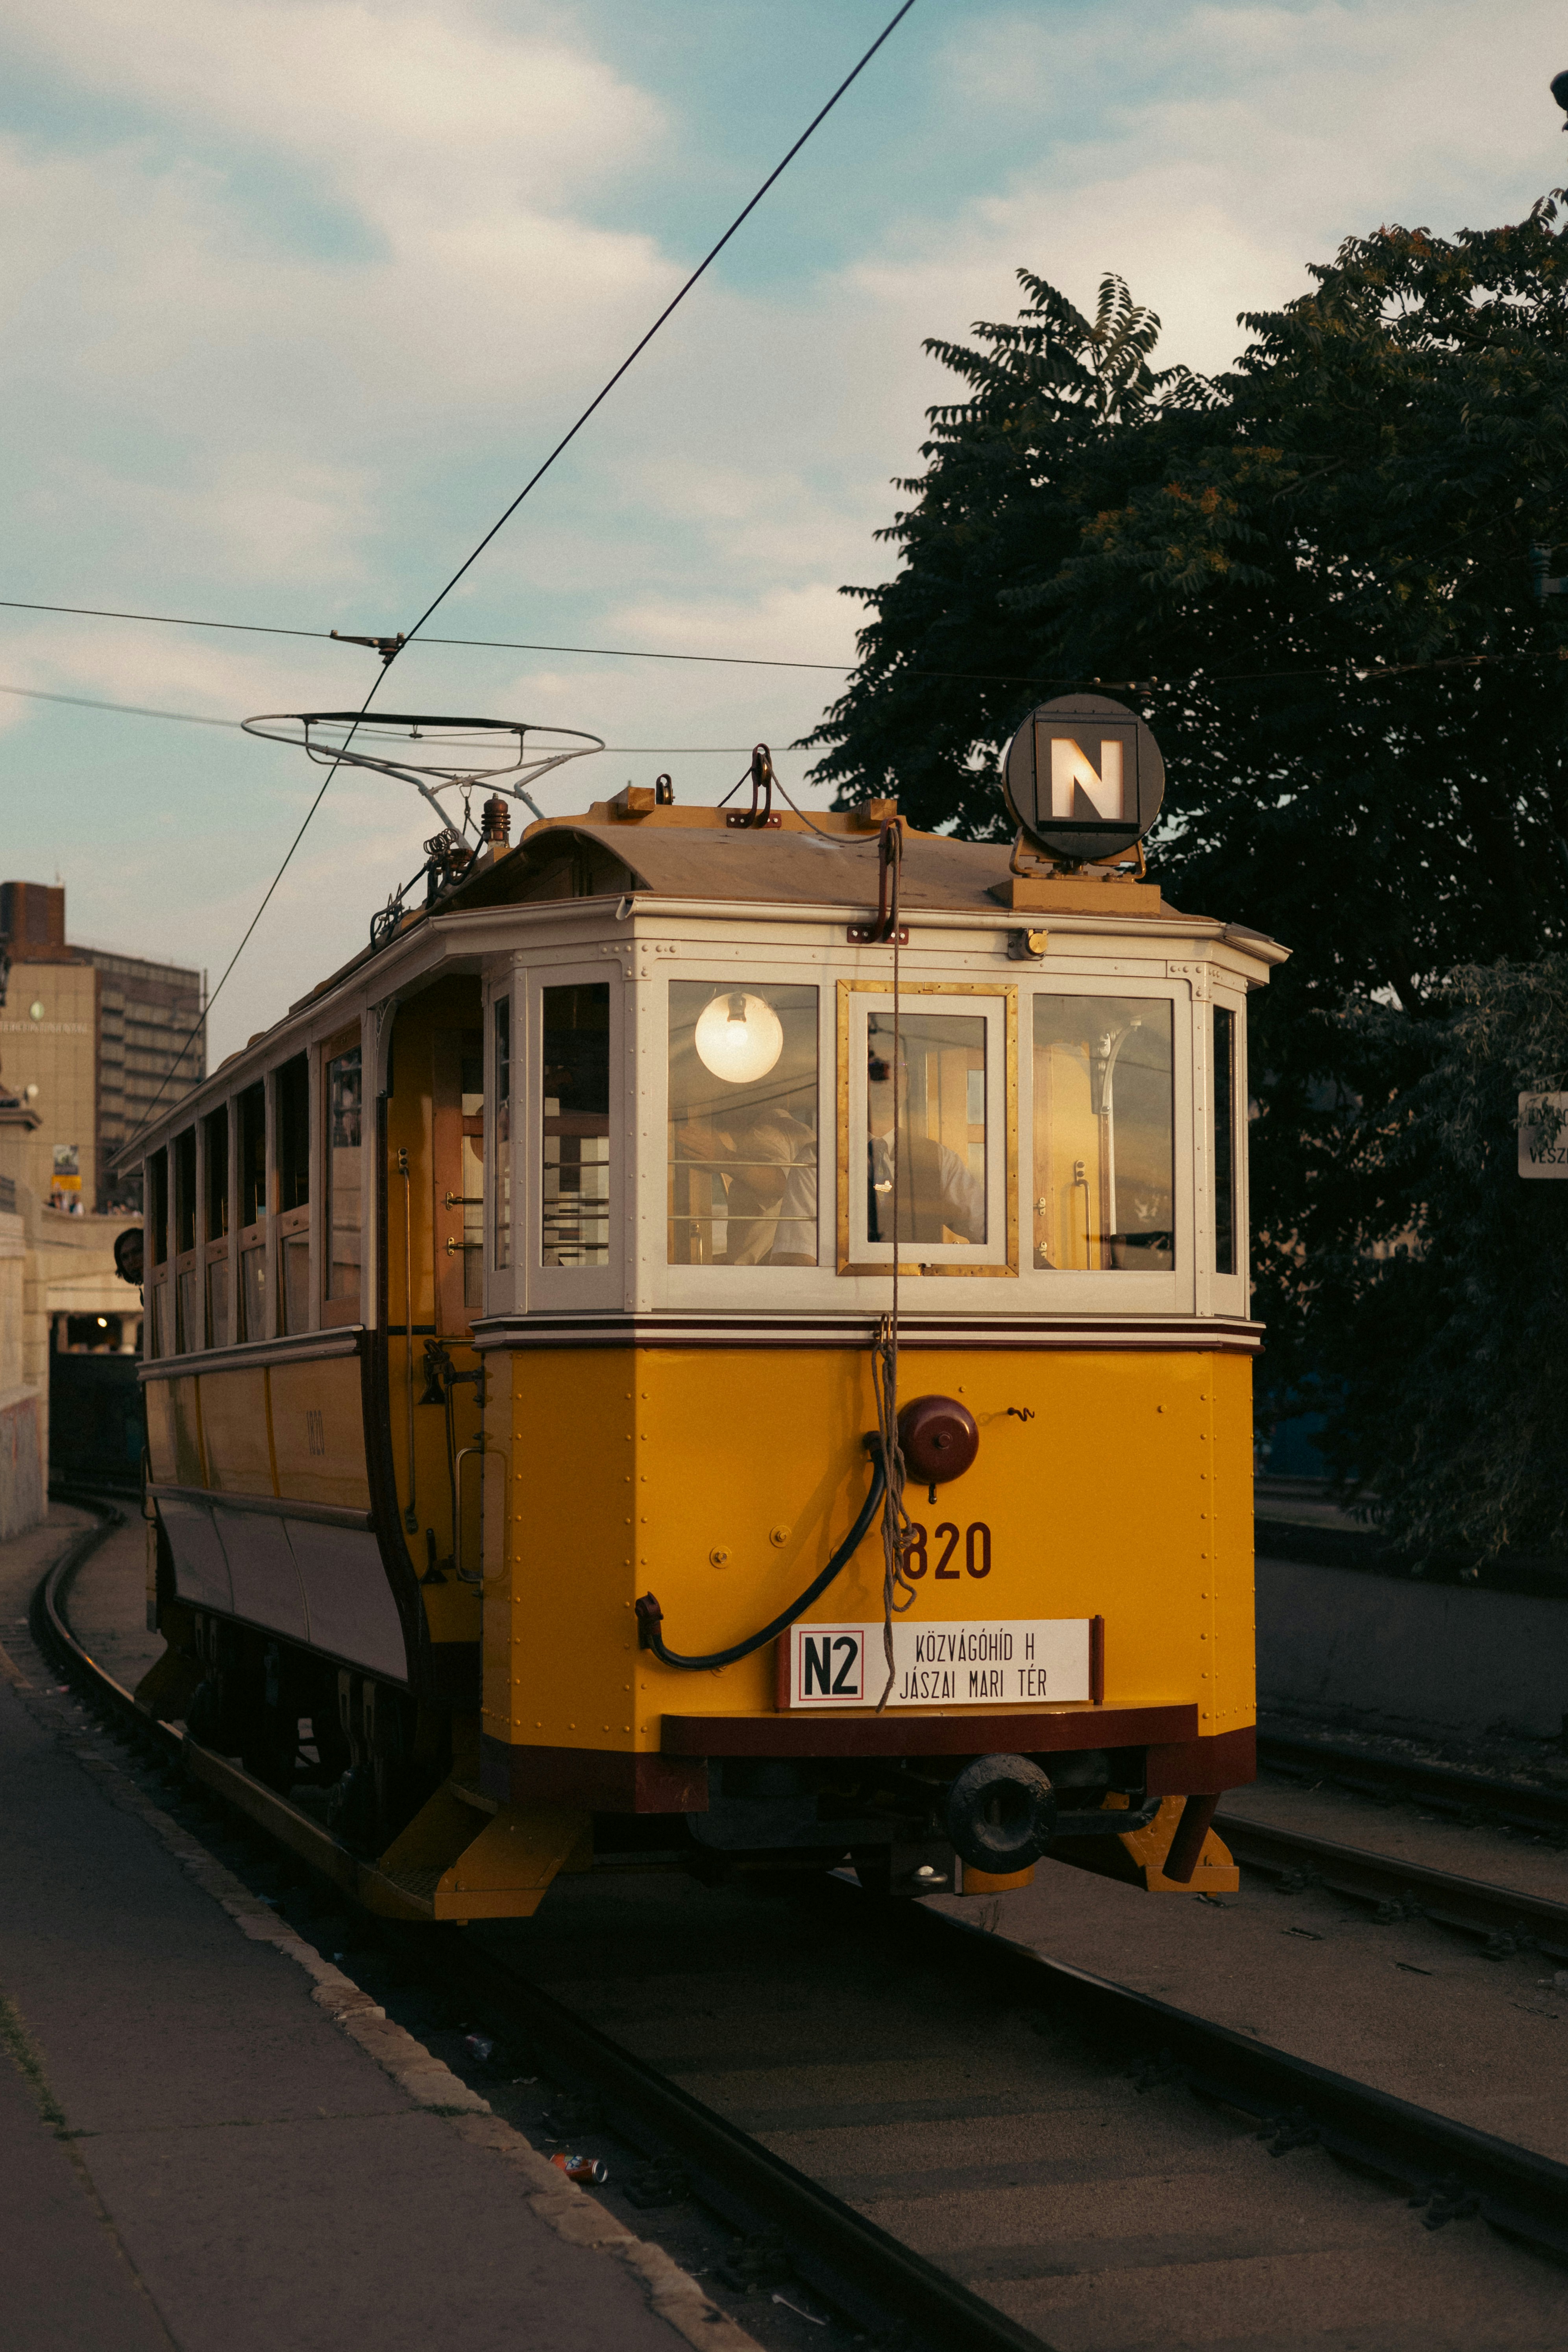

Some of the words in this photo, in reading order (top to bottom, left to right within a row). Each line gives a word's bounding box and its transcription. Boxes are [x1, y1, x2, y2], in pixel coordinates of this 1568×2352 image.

[1051, 738, 1124, 819] N
[1529, 1147, 1568, 1163] VESZ
[891, 1522, 991, 1580] 820
[804, 1636, 859, 1695] N2
[916, 1628, 1013, 1663] KÖZVÁGÓHÍD
[1025, 1633, 1035, 1660] H
[899, 1666, 955, 1699] JÁSZAI
[969, 1670, 1004, 1698] MARI
[1018, 1664, 1047, 1697] TÉR
